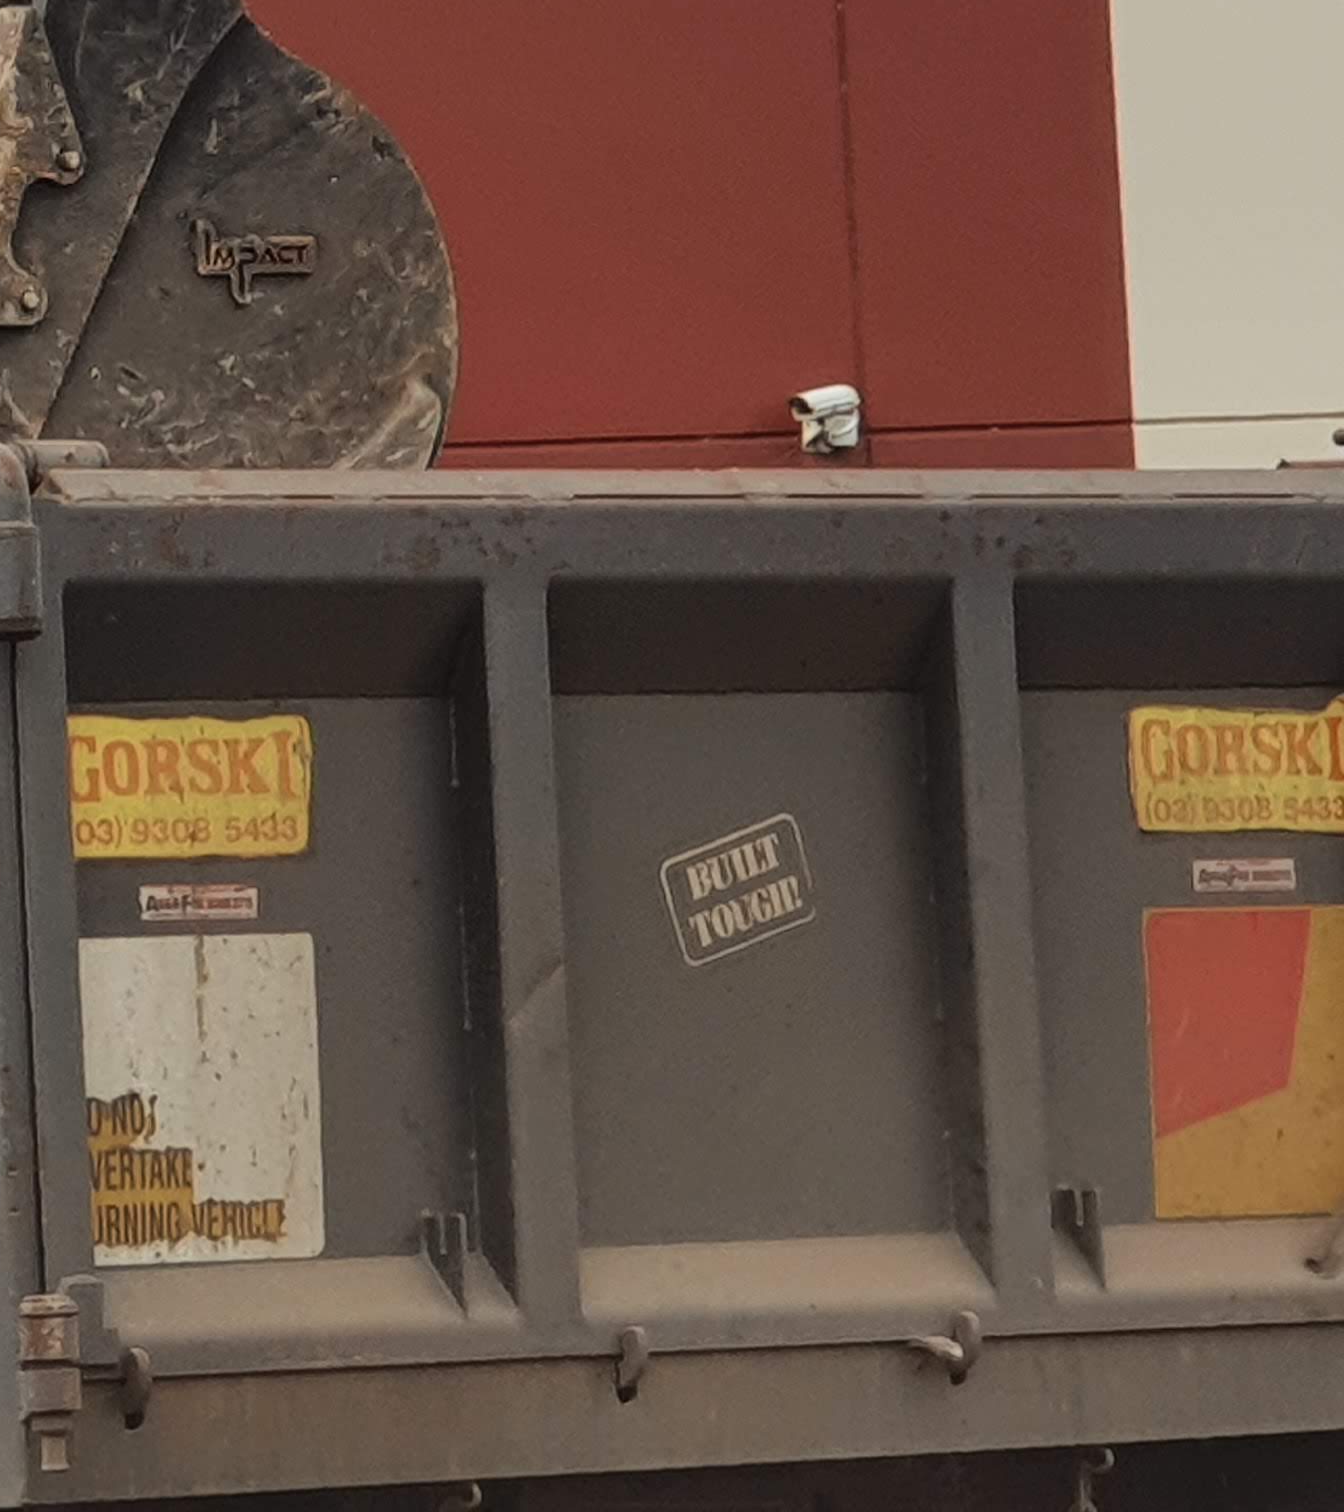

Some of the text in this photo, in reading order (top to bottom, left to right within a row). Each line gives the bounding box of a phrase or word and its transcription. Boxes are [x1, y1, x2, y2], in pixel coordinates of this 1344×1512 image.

[68, 730, 298, 805] GORSKI
[1141, 715, 1344, 784] GORSKI
[75, 814, 298, 848] 03) 9308 5433
[685, 831, 780, 901] BUILT
[89, 1146, 194, 1193] VERTAKE
